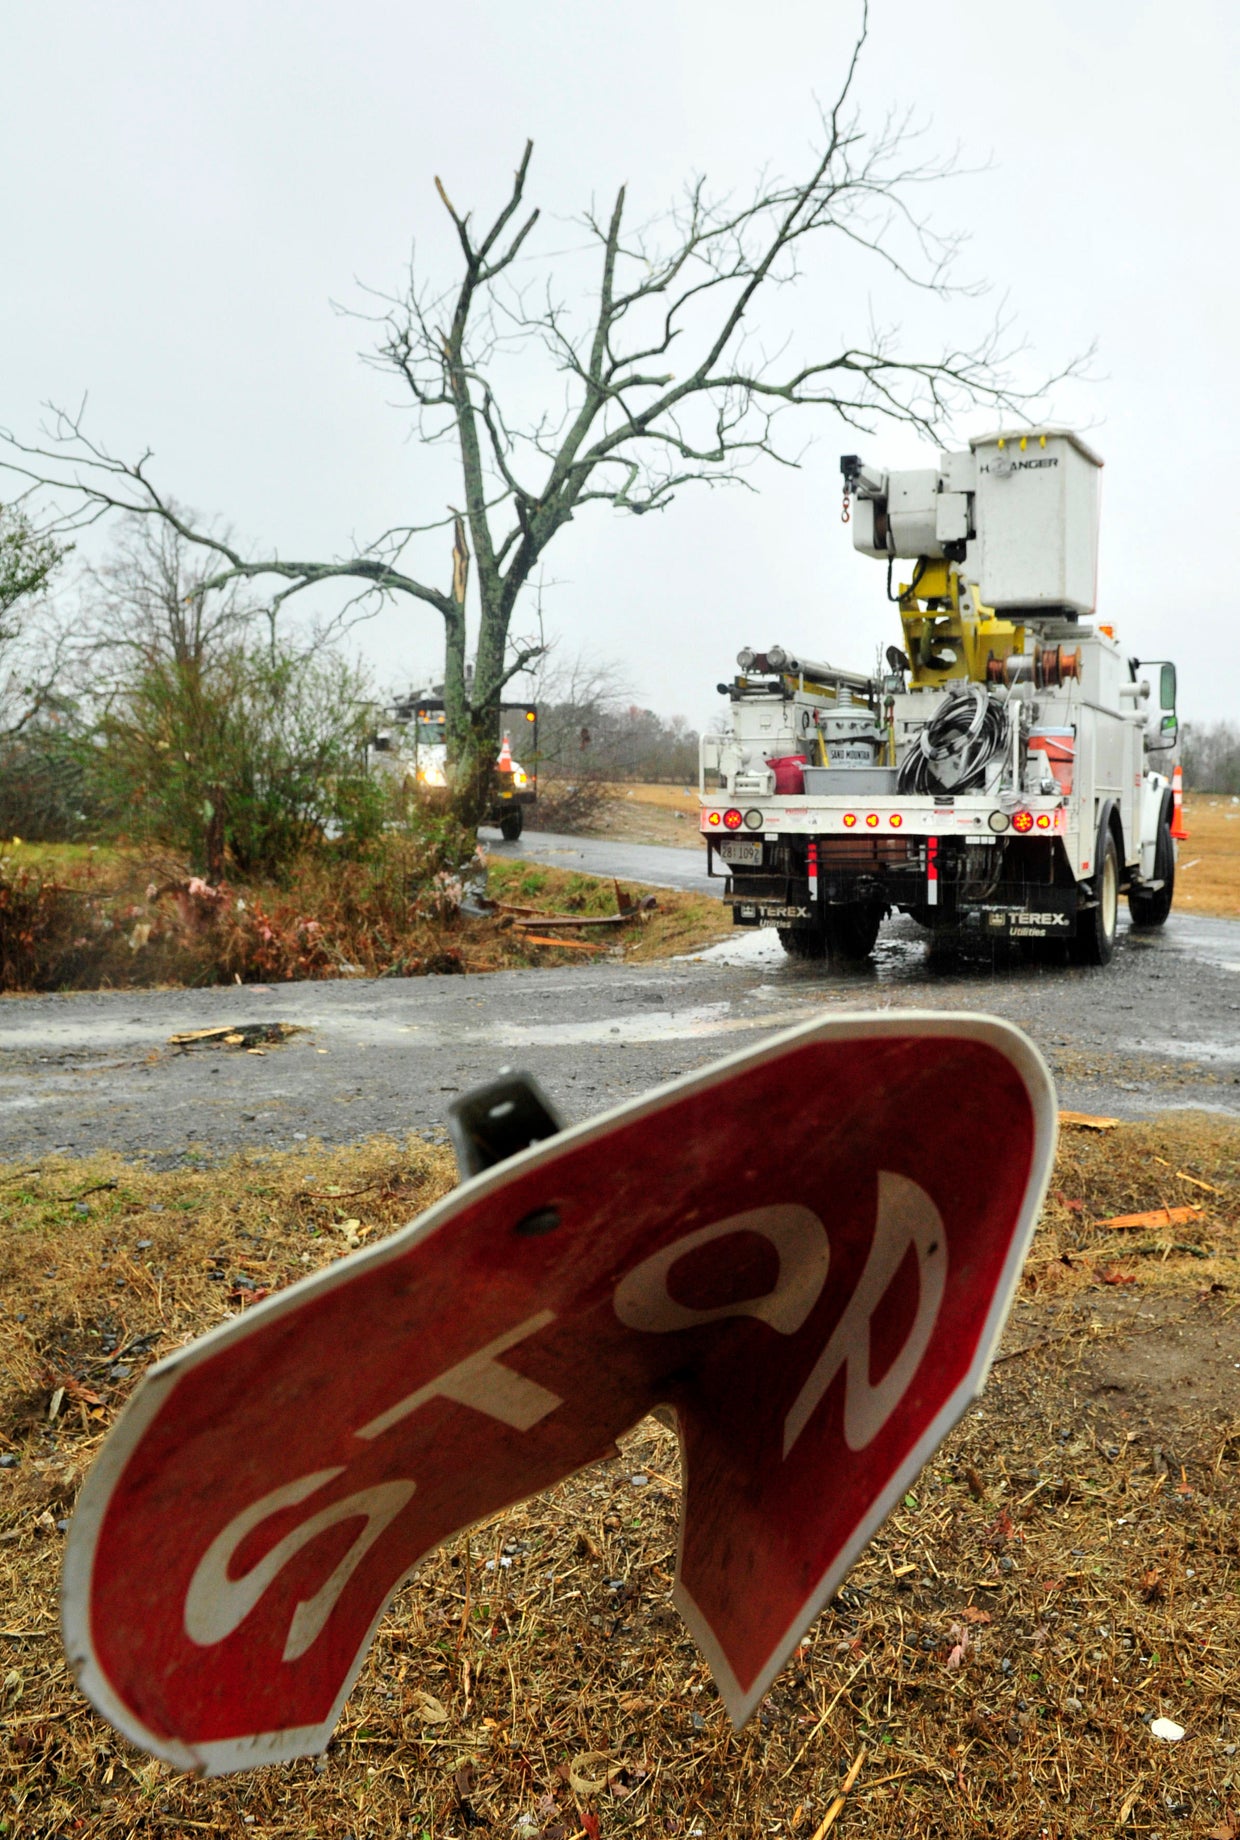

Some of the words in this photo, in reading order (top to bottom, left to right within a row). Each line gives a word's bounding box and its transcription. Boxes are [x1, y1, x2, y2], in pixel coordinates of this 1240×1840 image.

[758, 905, 808, 918] TEREX
[1008, 912, 1065, 926] TEREX
[1009, 926, 1047, 937] Utilities
[184, 1170, 948, 1662] STOP
